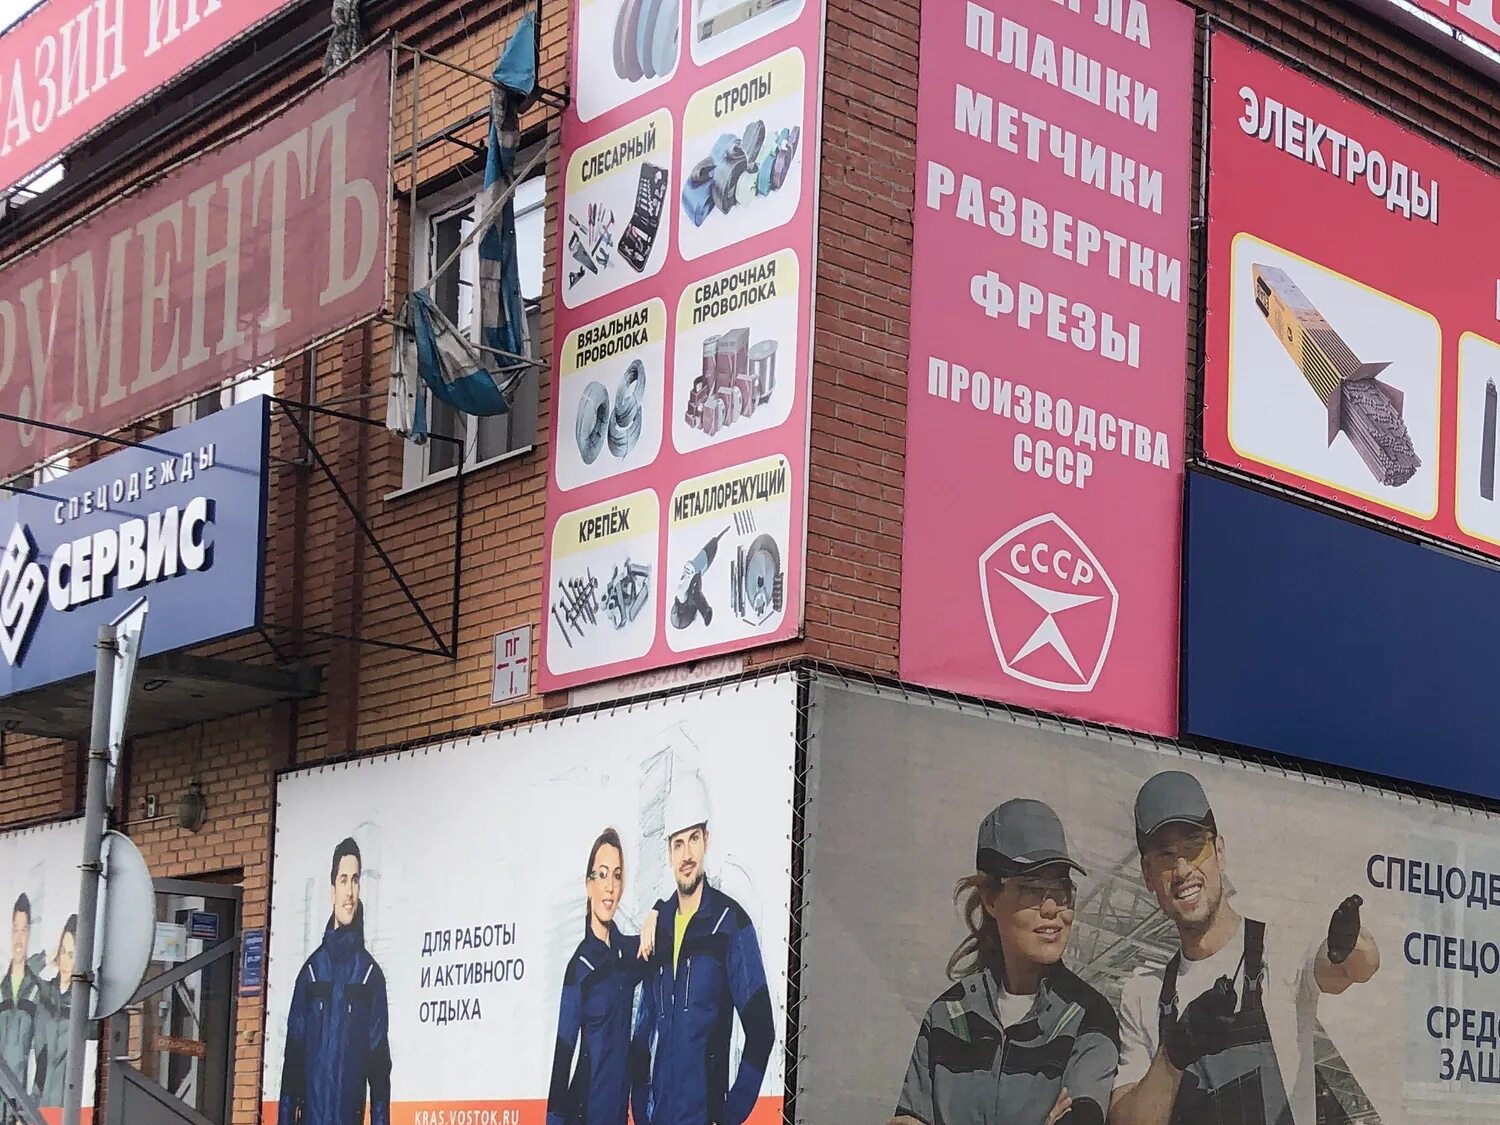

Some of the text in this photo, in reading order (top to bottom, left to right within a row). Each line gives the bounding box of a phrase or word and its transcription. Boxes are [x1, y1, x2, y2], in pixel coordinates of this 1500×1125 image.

[965, 1, 1158, 132] ПЛАШКИ
[714, 72, 771, 118] СТРОПЫ
[581, 121, 656, 182] СЛЕСАРНЫЙ
[955, 84, 1162, 215] МЕТЧИКИ
[1239, 87, 1439, 224] ЭЛЕКТРОДЫ
[926, 160, 1181, 303] РАЗВЕРТКИ
[0, 102, 380, 447] УМЕНТЪ
[695, 260, 776, 304] СВАРОЧНАЯ
[577, 307, 649, 350] ВЯЗАЛЬНАЯ
[693, 281, 776, 325] ПРОВОЛОКА
[971, 270, 1140, 368] ФРЕЗЫ
[575, 328, 649, 369] ПРОВОЛОКА
[928, 356, 1170, 470] ПРОИЗВОДСТВА
[54, 444, 216, 524] СПЕЦОДЕЖДЫ
[1014, 433, 1093, 489] СССР
[674, 460, 786, 521] МЕТАЛЛОРЕЖУЩИЙ
[579, 506, 630, 543] КРЕПЁЖ
[49, 497, 216, 611] СЕРВИС
[1010, 543, 1094, 588] СССР
[505, 637, 520, 657] ПГ
[421, 922, 516, 957] ДЛЯ РАБОТЫ
[420, 958, 525, 988] И АКТИВНОГО
[419, 998, 482, 1026] ОТДЫХА
[415, 1109, 519, 1125] KRAS.VOSTOK.RU
